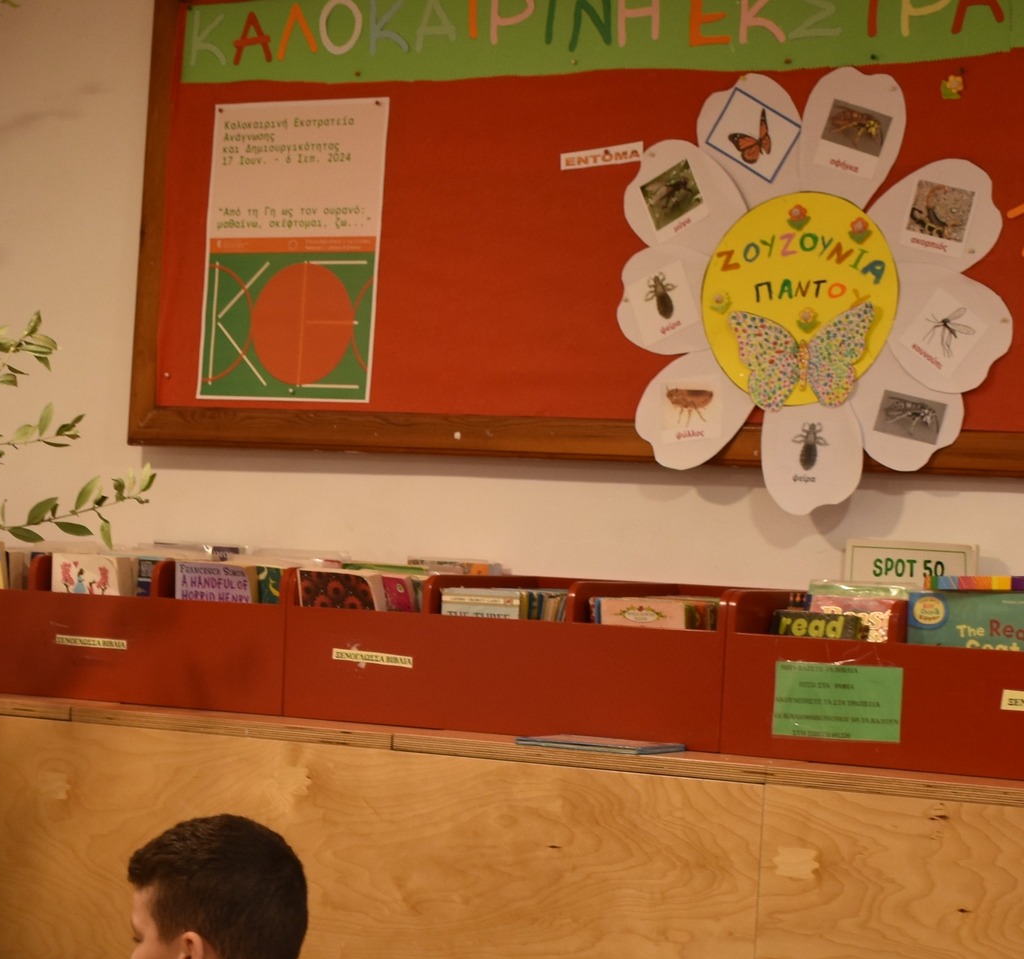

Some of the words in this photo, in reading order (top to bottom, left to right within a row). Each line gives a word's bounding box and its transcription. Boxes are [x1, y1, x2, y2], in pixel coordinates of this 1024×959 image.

[222, 157, 233, 166] 17
[285, 155, 292, 164] 6
[327, 153, 351, 163] 2024
[564, 149, 641, 167] ΕΝΤΟΜΑ
[716, 231, 886, 286] ΖΟΥΖΟΥΝΙΑ
[872, 557, 917, 579] SPOT
[922, 558, 946, 578] 50
[181, 574, 188, 588] A
[190, 575, 236, 590] HANDFUL
[237, 579, 249, 591] OF
[778, 615, 845, 639] read
[956, 624, 985, 638] The
